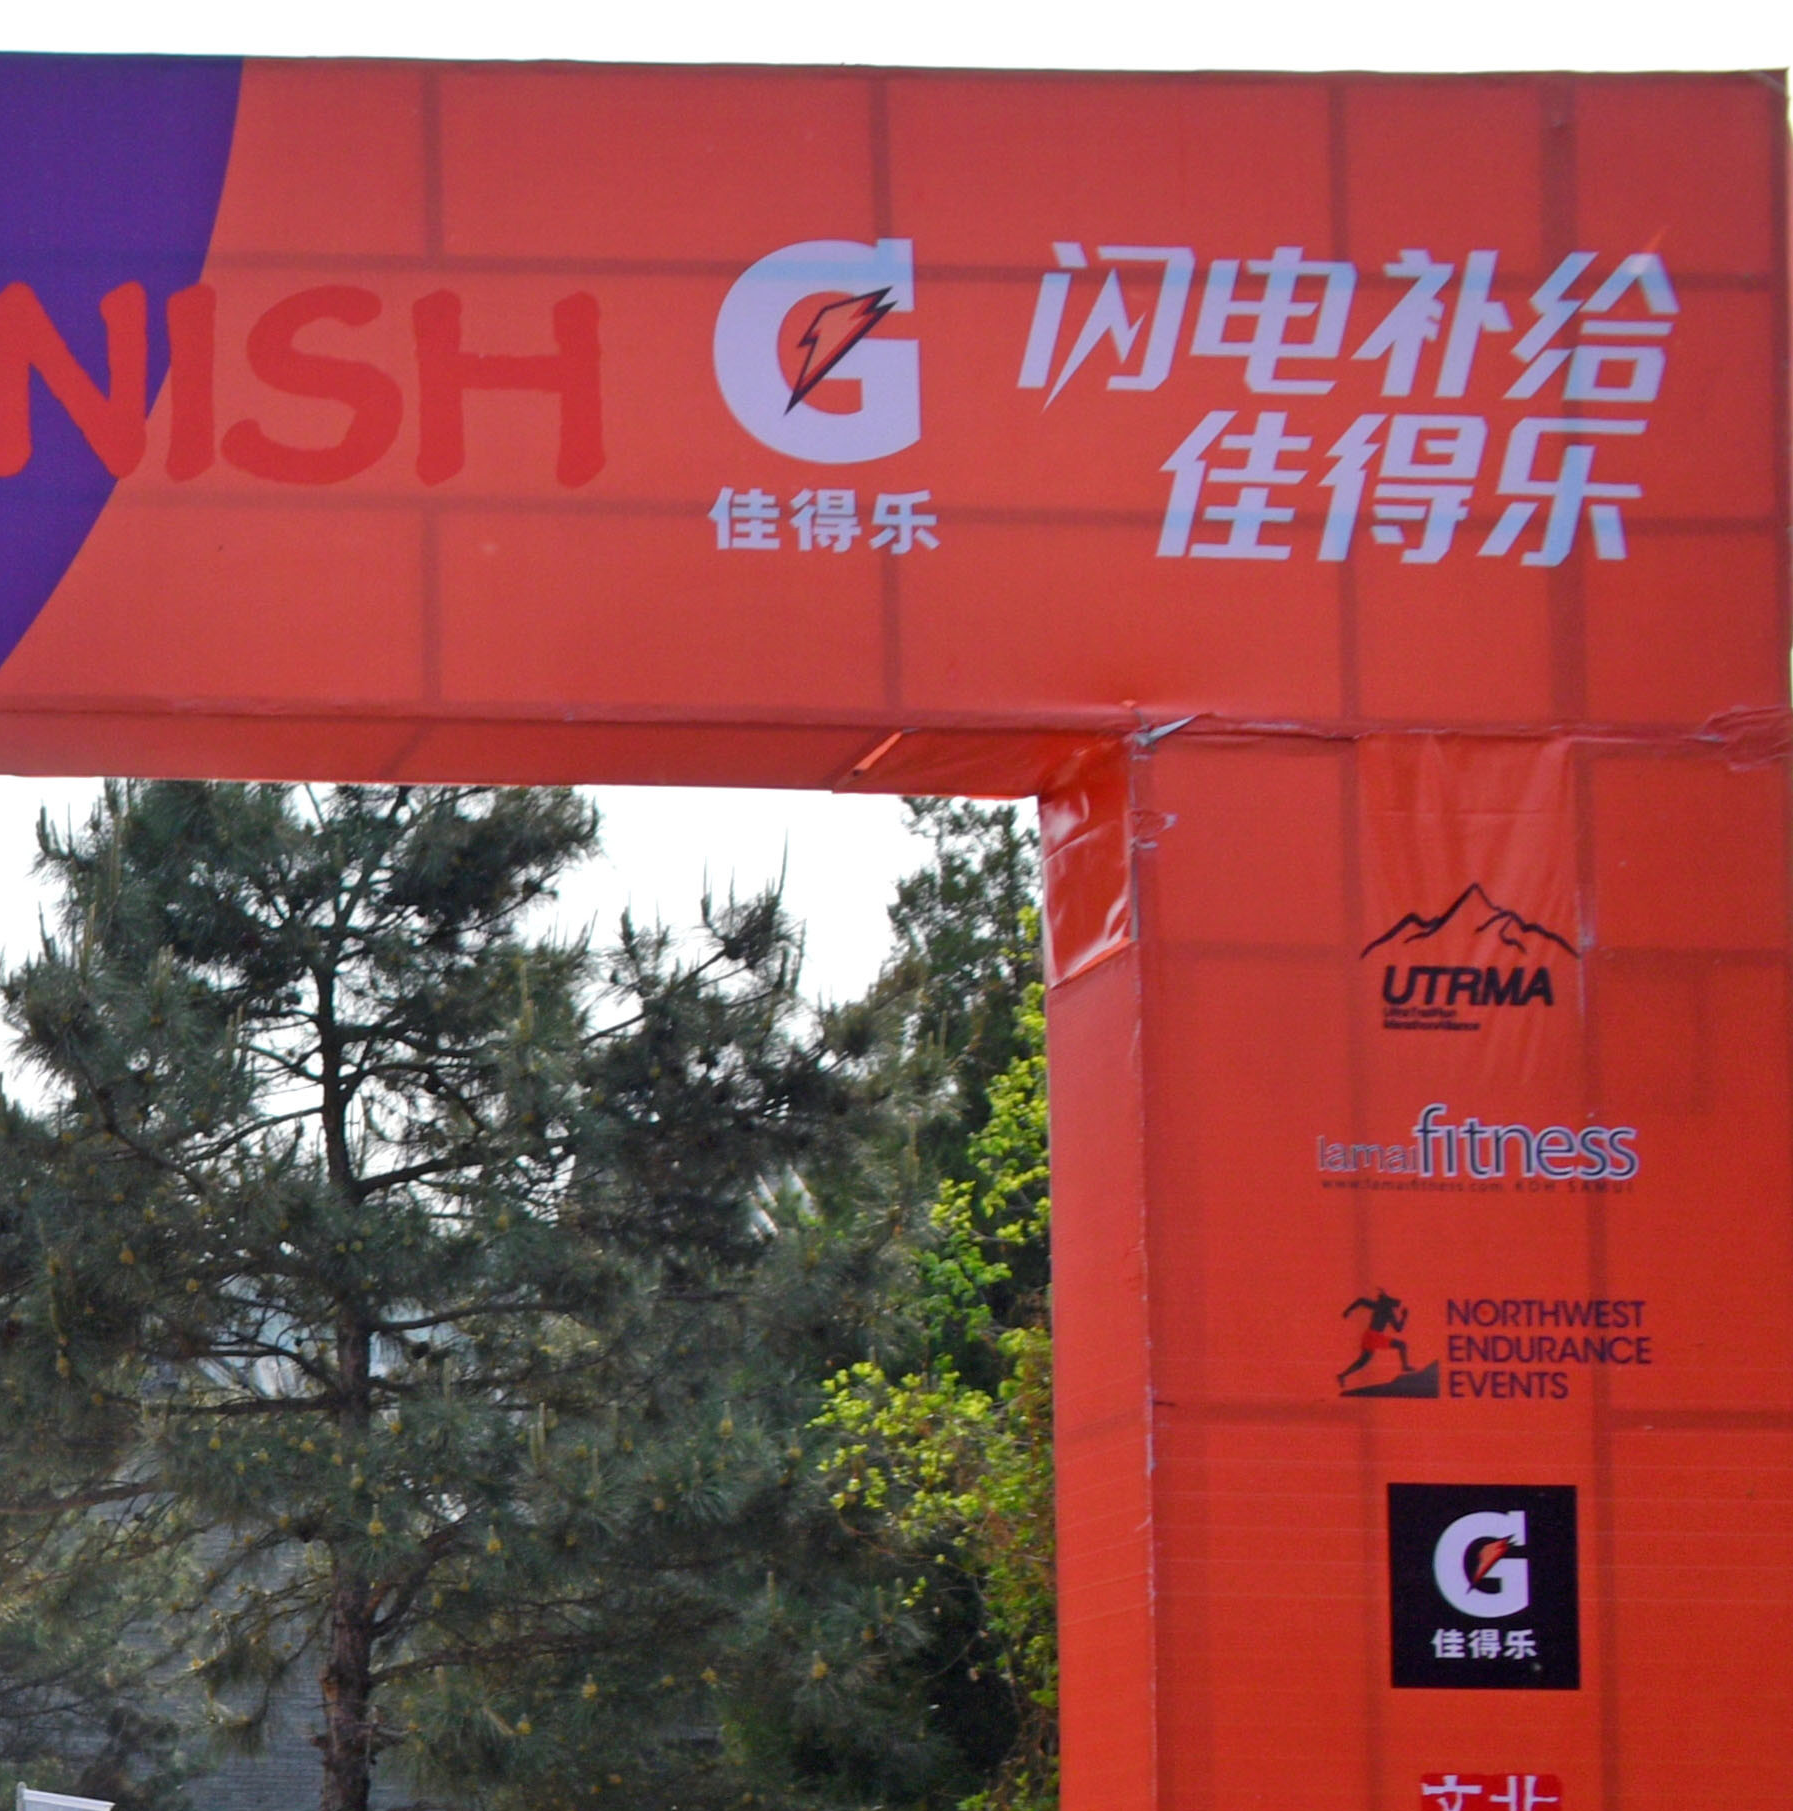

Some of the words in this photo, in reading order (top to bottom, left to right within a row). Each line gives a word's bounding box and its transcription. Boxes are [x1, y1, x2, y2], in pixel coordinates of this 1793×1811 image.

[1017, 241, 1681, 412] 闪电补给
[1154, 409, 1648, 567] 佳得乐
[709, 487, 941, 554] 佳得乐
[1382, 966, 1554, 1006] UTRMA
[1446, 1299, 1644, 1328] NORTHWEST
[1447, 1335, 1653, 1364] ENDURANCE
[1448, 1371, 1569, 1399] EVENTS
[1431, 1628, 1537, 1659] 佳得乐
